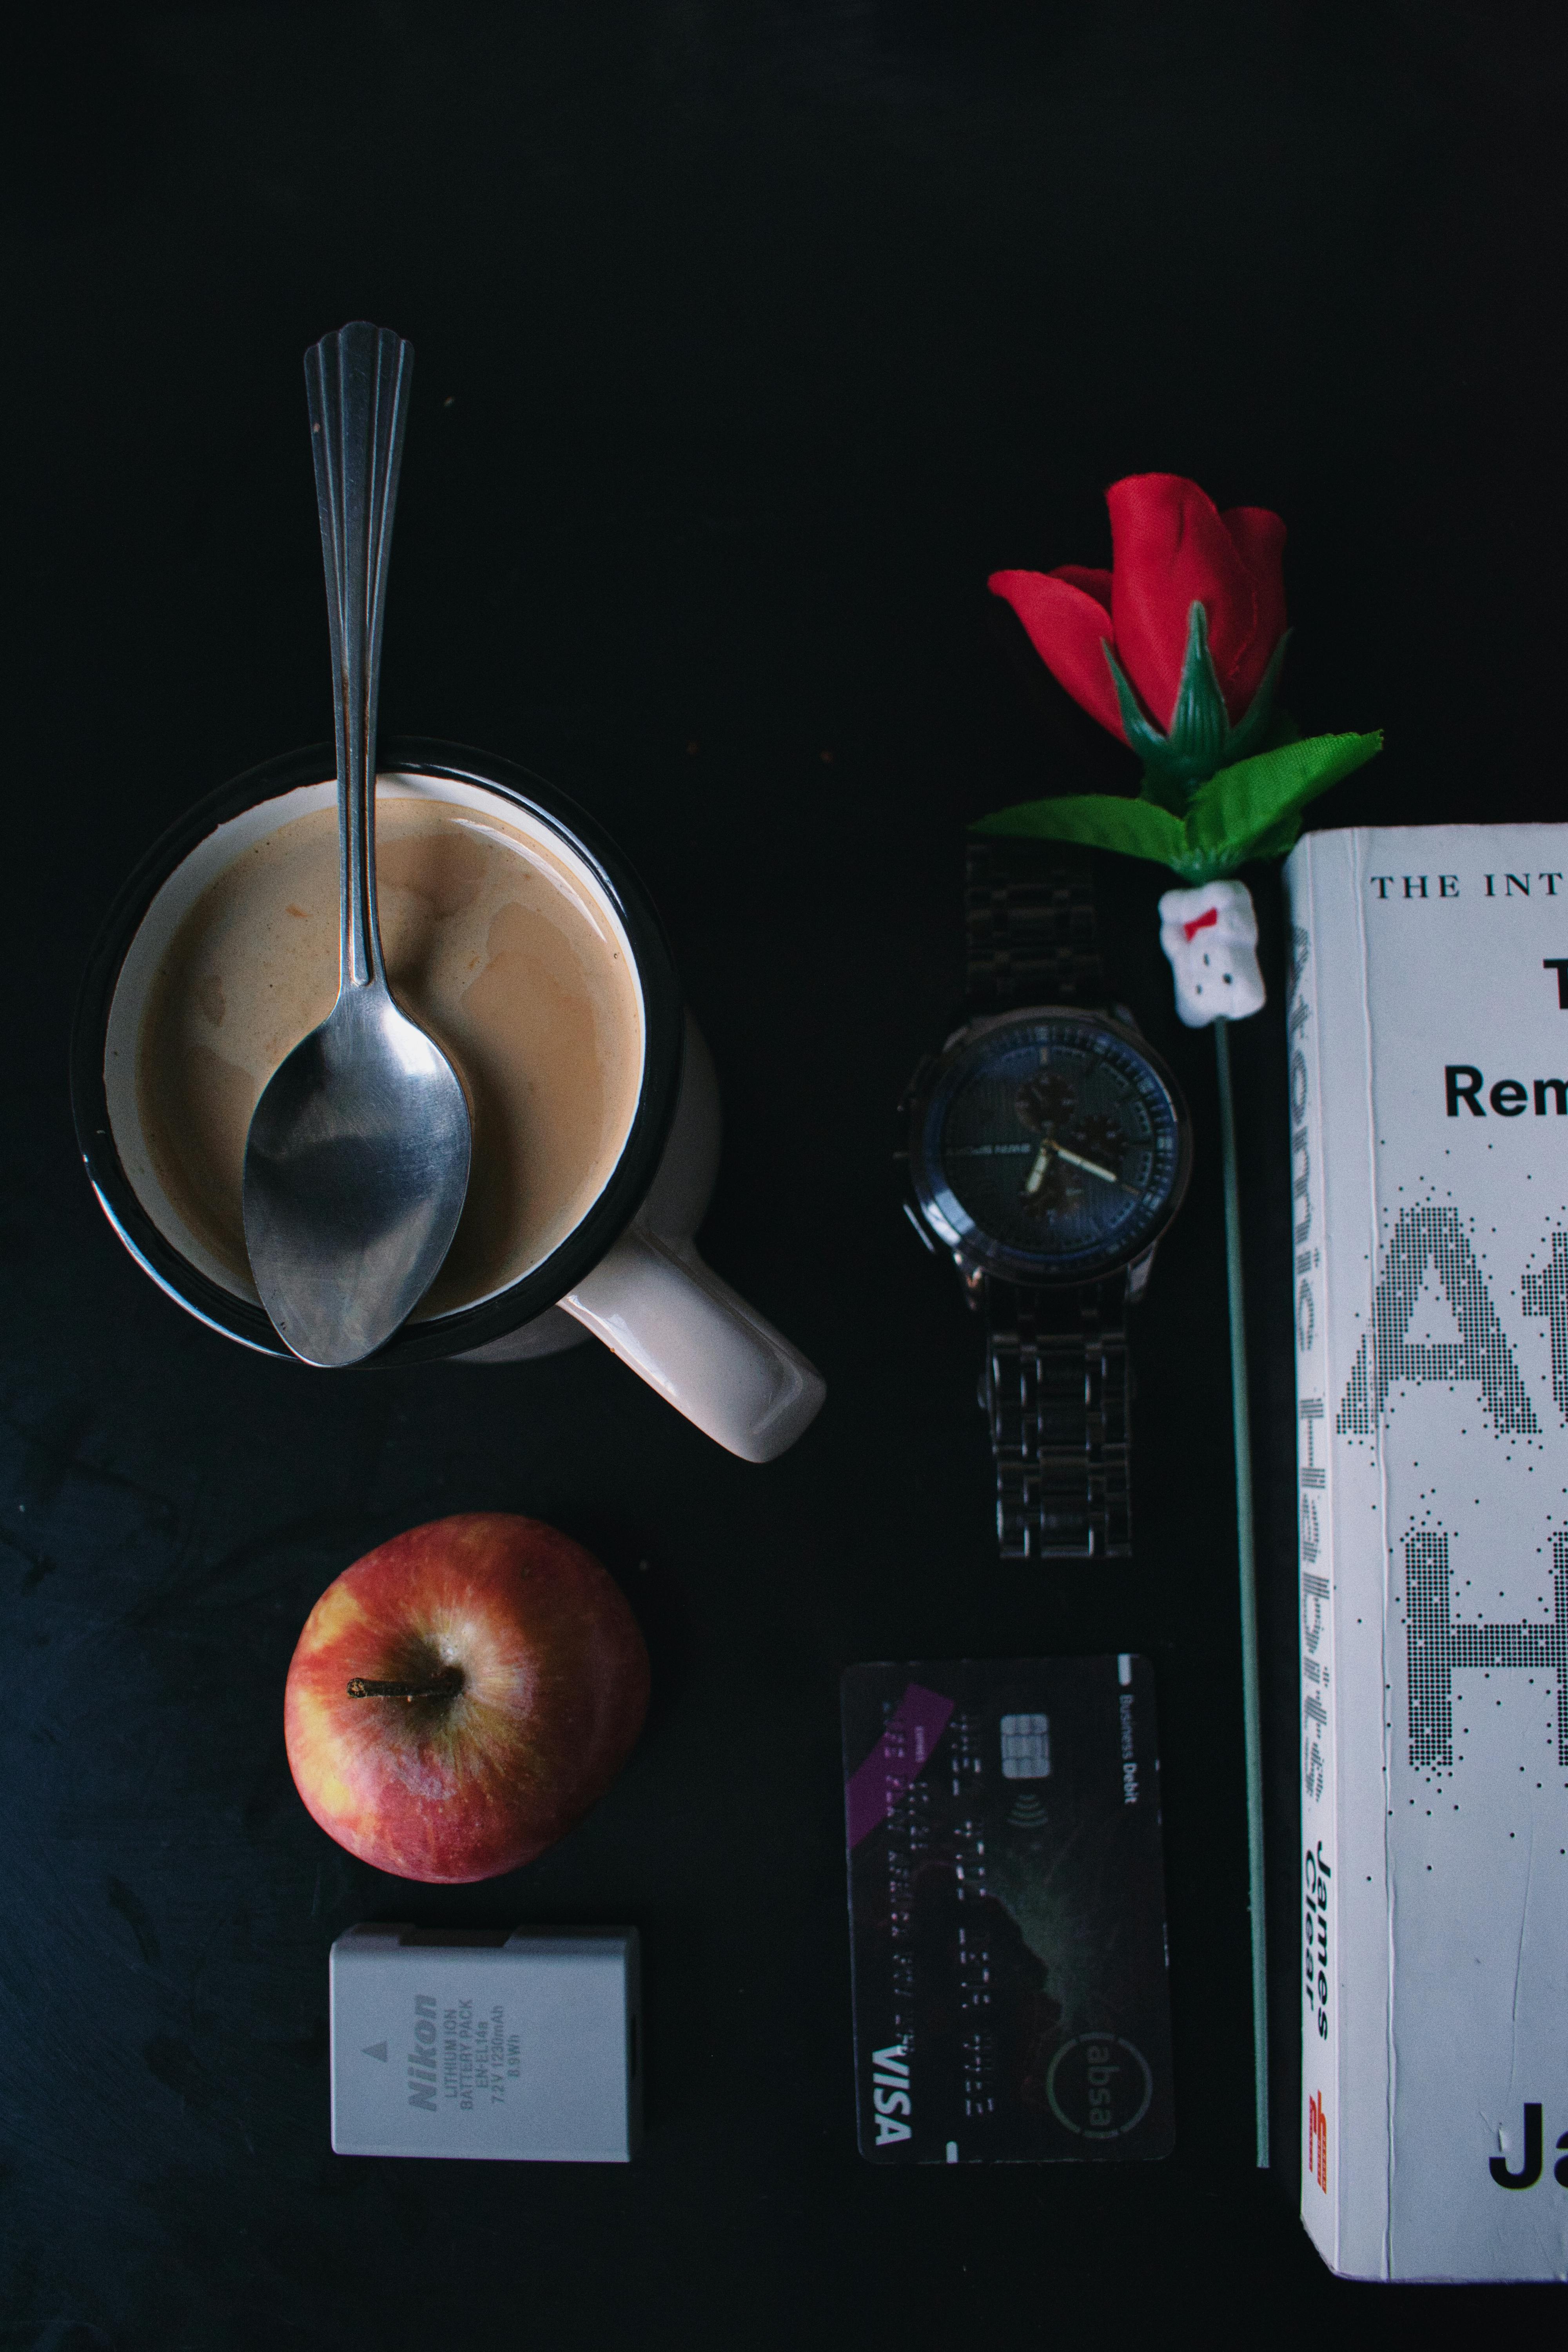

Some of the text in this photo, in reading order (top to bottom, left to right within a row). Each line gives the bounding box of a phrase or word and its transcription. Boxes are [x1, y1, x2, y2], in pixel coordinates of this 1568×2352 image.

[1370, 872, 1563, 899] THE INT
[1445, 1064, 1568, 1117] Rem
[1299, 1398, 1329, 1802] Habits
[1119, 1694, 1140, 1804] Business Debit
[1305, 1849, 1317, 2012] Clear
[1317, 1840, 1332, 2040] James
[408, 1994, 437, 2112] Nikon
[443, 2009, 458, 2098] LITHIUM ION
[459, 1999, 473, 2111] BATTERY PACK
[491, 2005, 504, 2068] 1230mAh
[508, 2034, 521, 2077] 8.9Wh
[872, 2043, 913, 2146] VISA
[1087, 2045, 1121, 2126] absa
[1489, 2102, 1568, 2191] J
